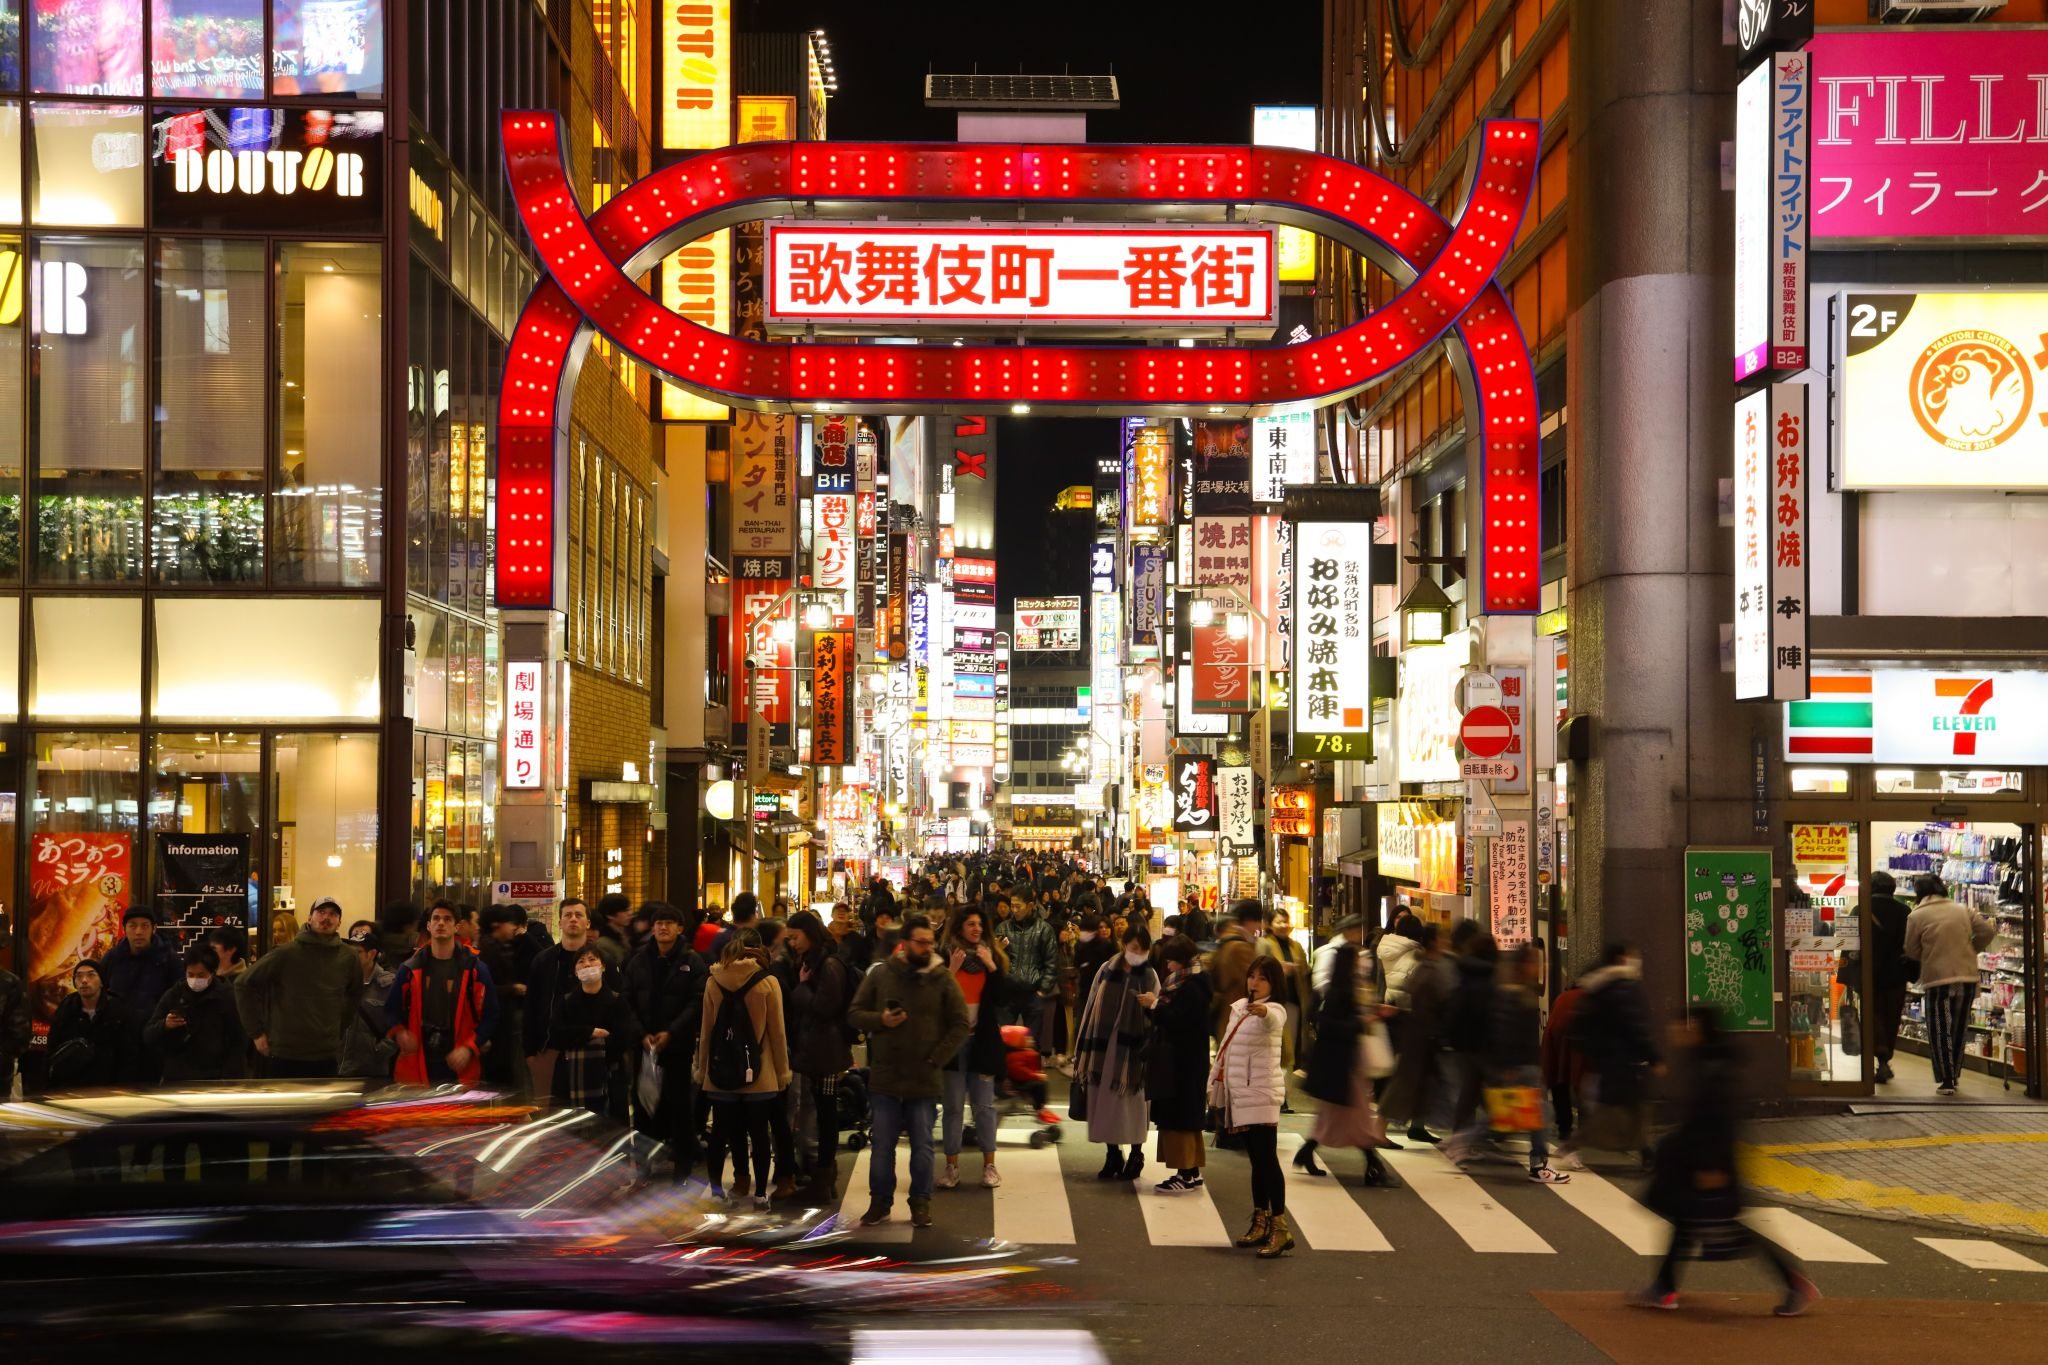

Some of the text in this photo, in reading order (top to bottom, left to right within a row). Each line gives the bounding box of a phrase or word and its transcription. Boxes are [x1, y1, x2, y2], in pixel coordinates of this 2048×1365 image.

[174, 147, 364, 198] DOUTOR
[1778, 84, 1803, 258] ファイトフィット
[789, 242, 1255, 308] 歌舞伎町一番街
[1782, 262, 1797, 342] 新宿歌舞伎町
[1850, 303, 1897, 337] 2F
[1776, 350, 1803, 366] B2F
[1930, 331, 2012, 351] YAKITORI CENTER
[1268, 426, 1287, 500] 東南荘
[817, 473, 851, 488] B1F
[1777, 412, 1801, 568] お好み焼
[751, 537, 773, 549] 3F
[743, 559, 782, 578] 焼肉
[1308, 557, 1340, 720] お好み焼本陣
[1776, 596, 1802, 670] 本陣
[1210, 629, 1241, 699] ステップ
[514, 671, 535, 777] 劇場通り
[1463, 764, 1510, 775] 自転車を除く
[1230, 773, 1252, 838] お好み焼き
[1756, 809, 1768, 820] 17
[1795, 826, 1848, 838] ATM
[38, 838, 124, 864] あつあつ
[167, 844, 239, 855] information
[1236, 847, 1254, 856] B1F
[54, 862, 108, 886] ミラノ
[1492, 869, 1500, 895] Camera
[1506, 831, 1518, 929] 防犯カメラ作動中
[1517, 826, 1528, 934] みなさまの安全を守ります
